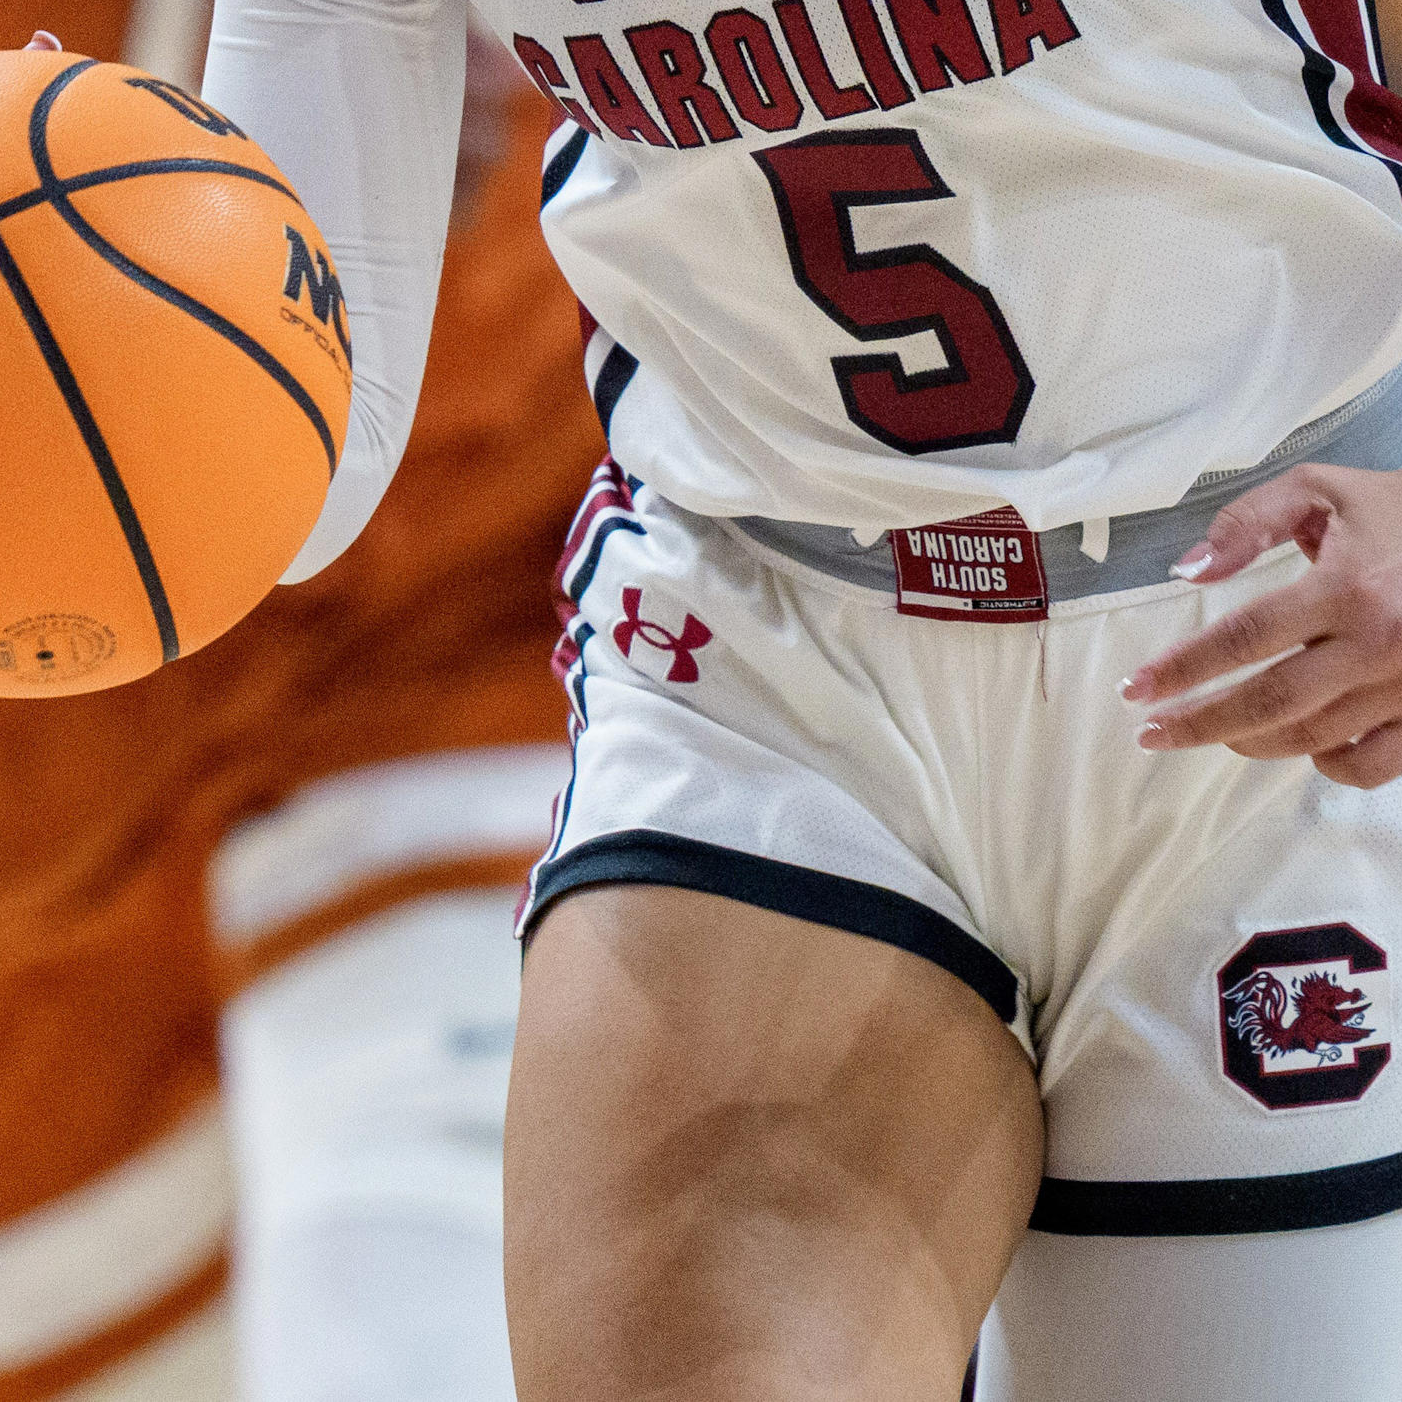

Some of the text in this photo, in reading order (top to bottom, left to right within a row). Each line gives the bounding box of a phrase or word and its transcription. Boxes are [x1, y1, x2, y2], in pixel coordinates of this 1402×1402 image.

[749, 127, 1036, 456] 5
[906, 529, 1024, 564] CAROLINA
[930, 561, 1008, 592] SOUTH
[979, 599, 1038, 609] AUTHENTIC
